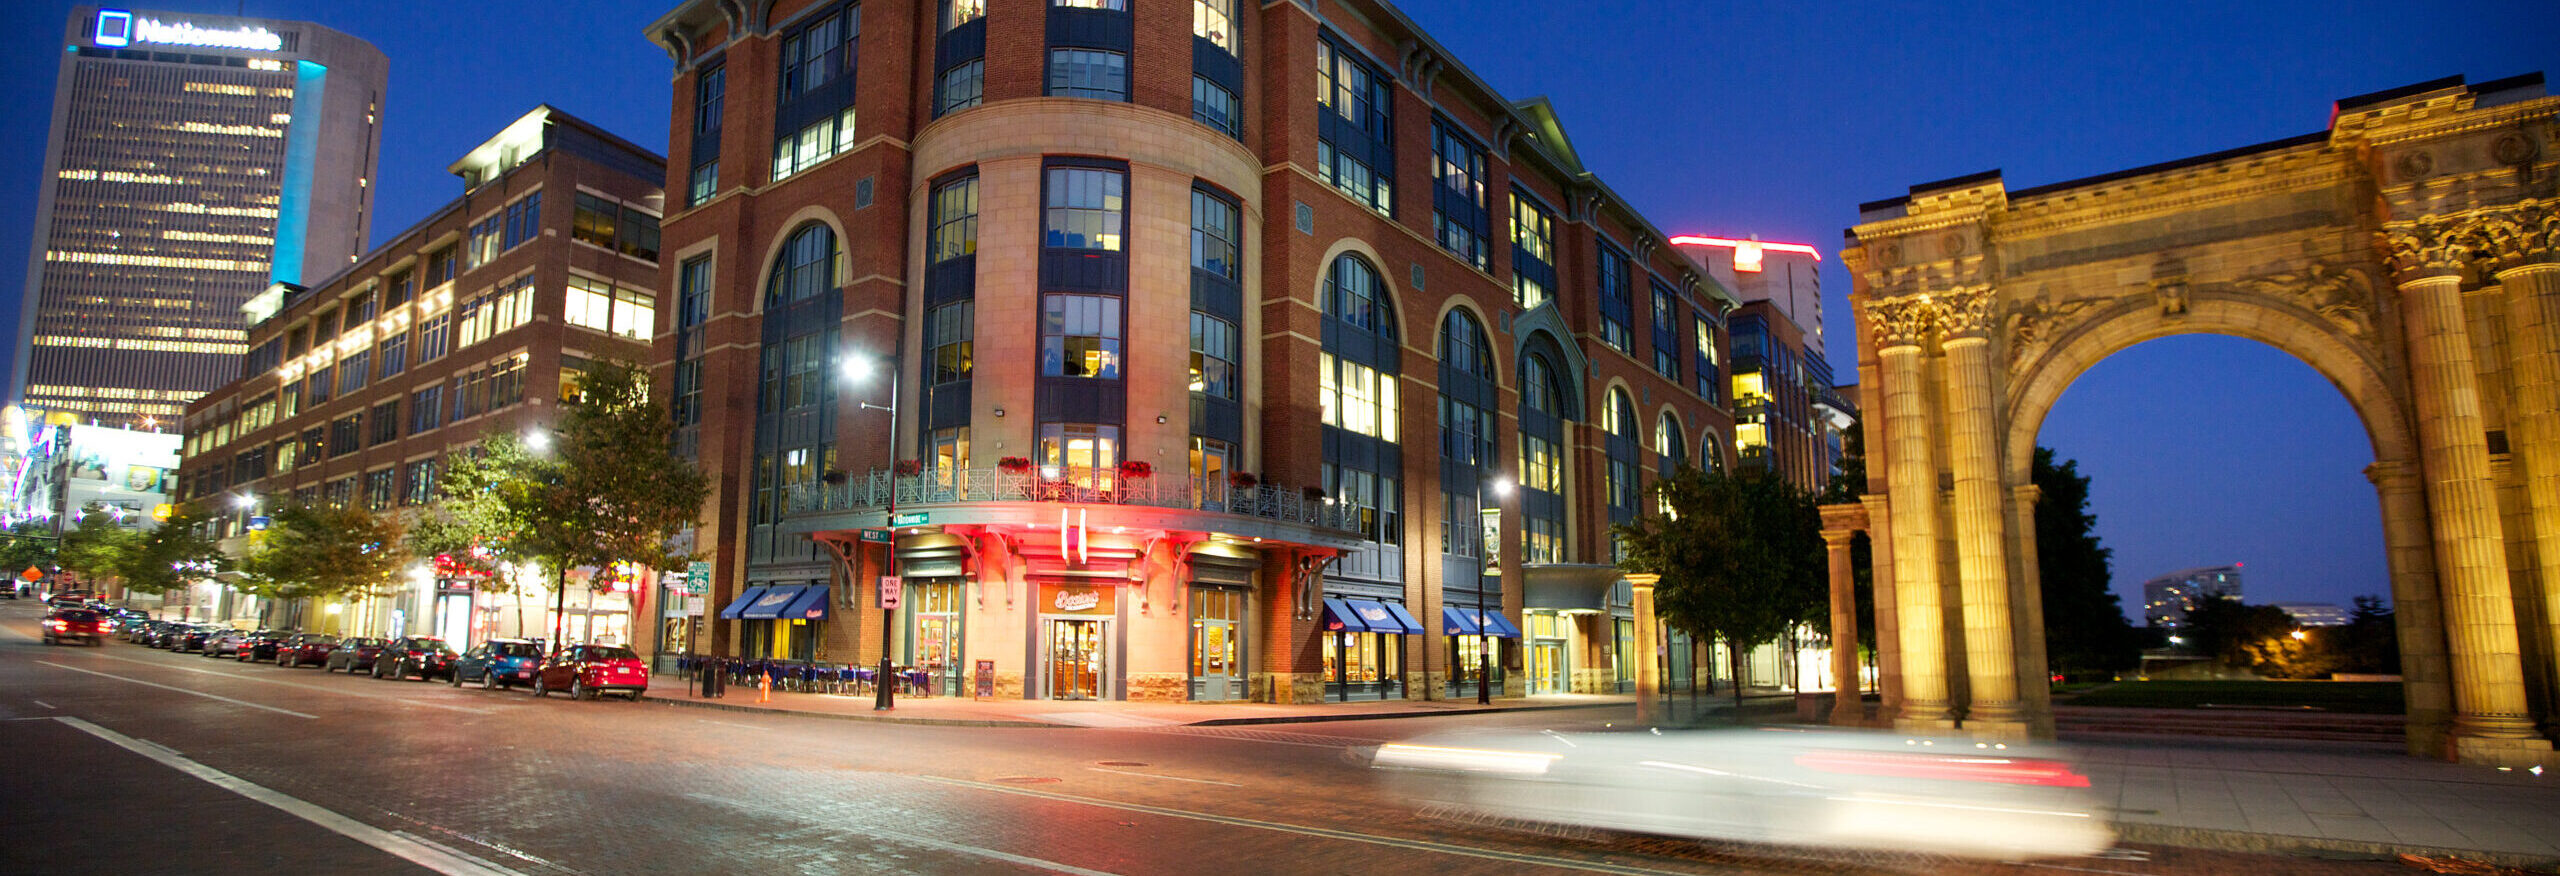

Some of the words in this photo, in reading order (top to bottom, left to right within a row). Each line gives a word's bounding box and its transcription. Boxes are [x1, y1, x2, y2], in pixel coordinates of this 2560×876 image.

[136, 17, 282, 51] Nationwide
[863, 530, 879, 539] WEST
[885, 579, 897, 587] ONE
